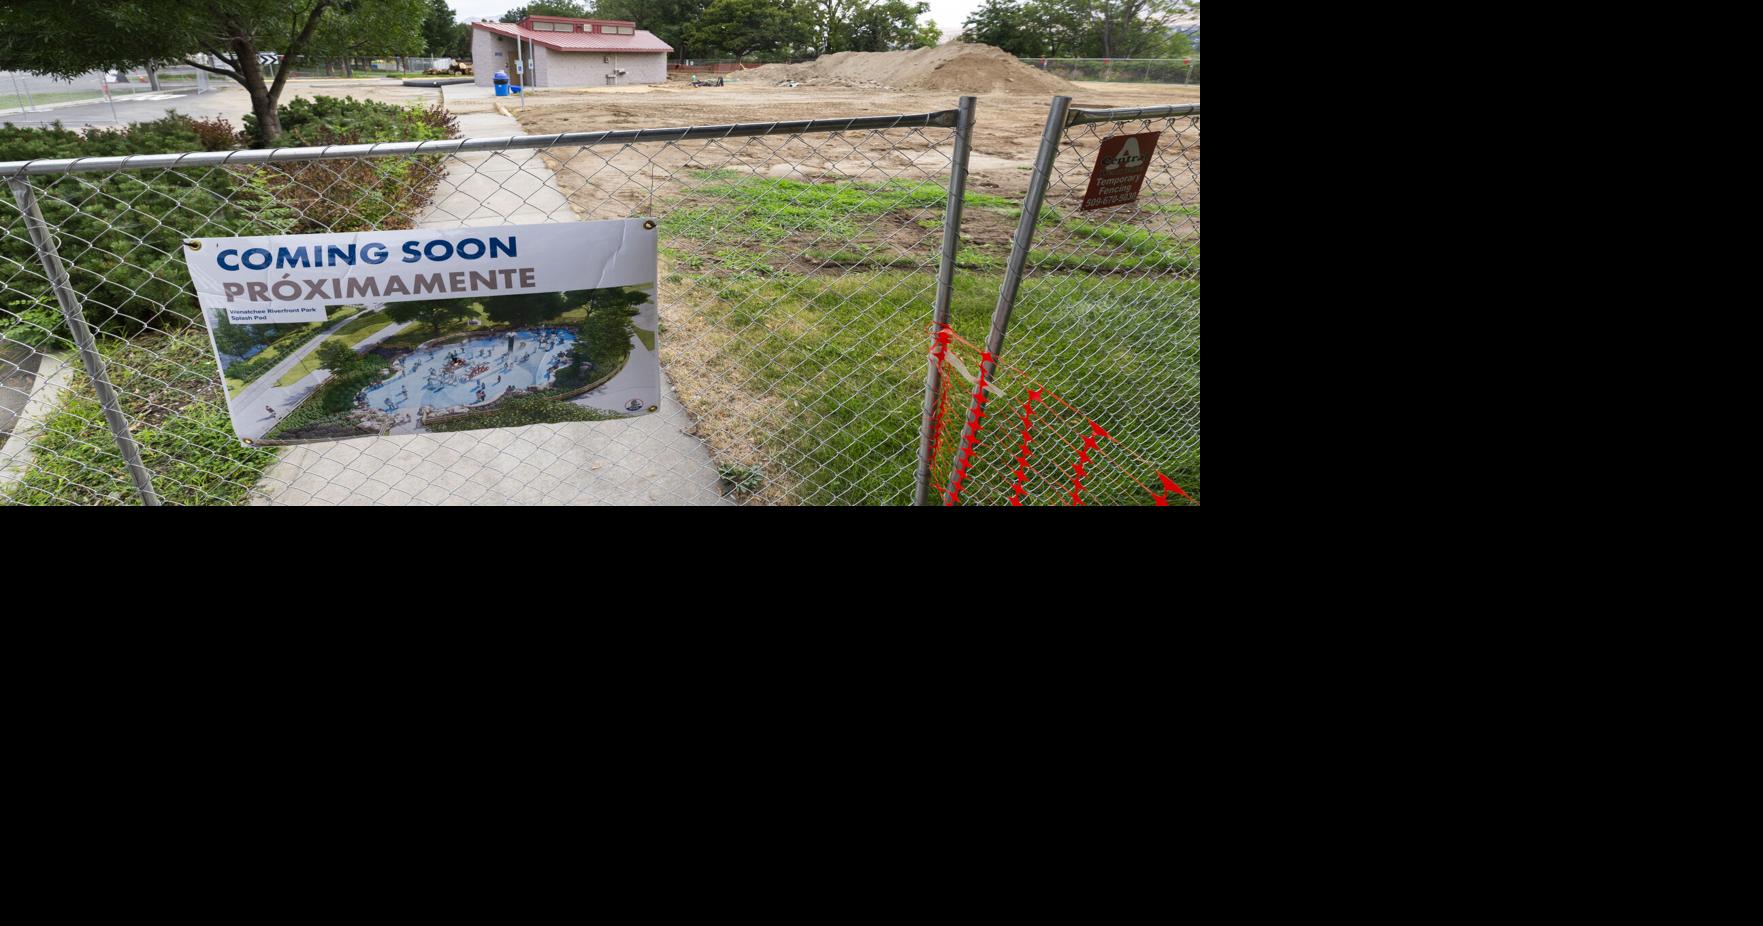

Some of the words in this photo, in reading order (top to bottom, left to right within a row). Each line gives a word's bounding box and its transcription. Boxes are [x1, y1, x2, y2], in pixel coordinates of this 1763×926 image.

[1097, 175, 1140, 186] Temporary
[1099, 185, 1132, 195] Fencing
[216, 242, 389, 271] COMING
[402, 236, 518, 264] SOON
[223, 268, 536, 302] PRÓXIMAMENTE
